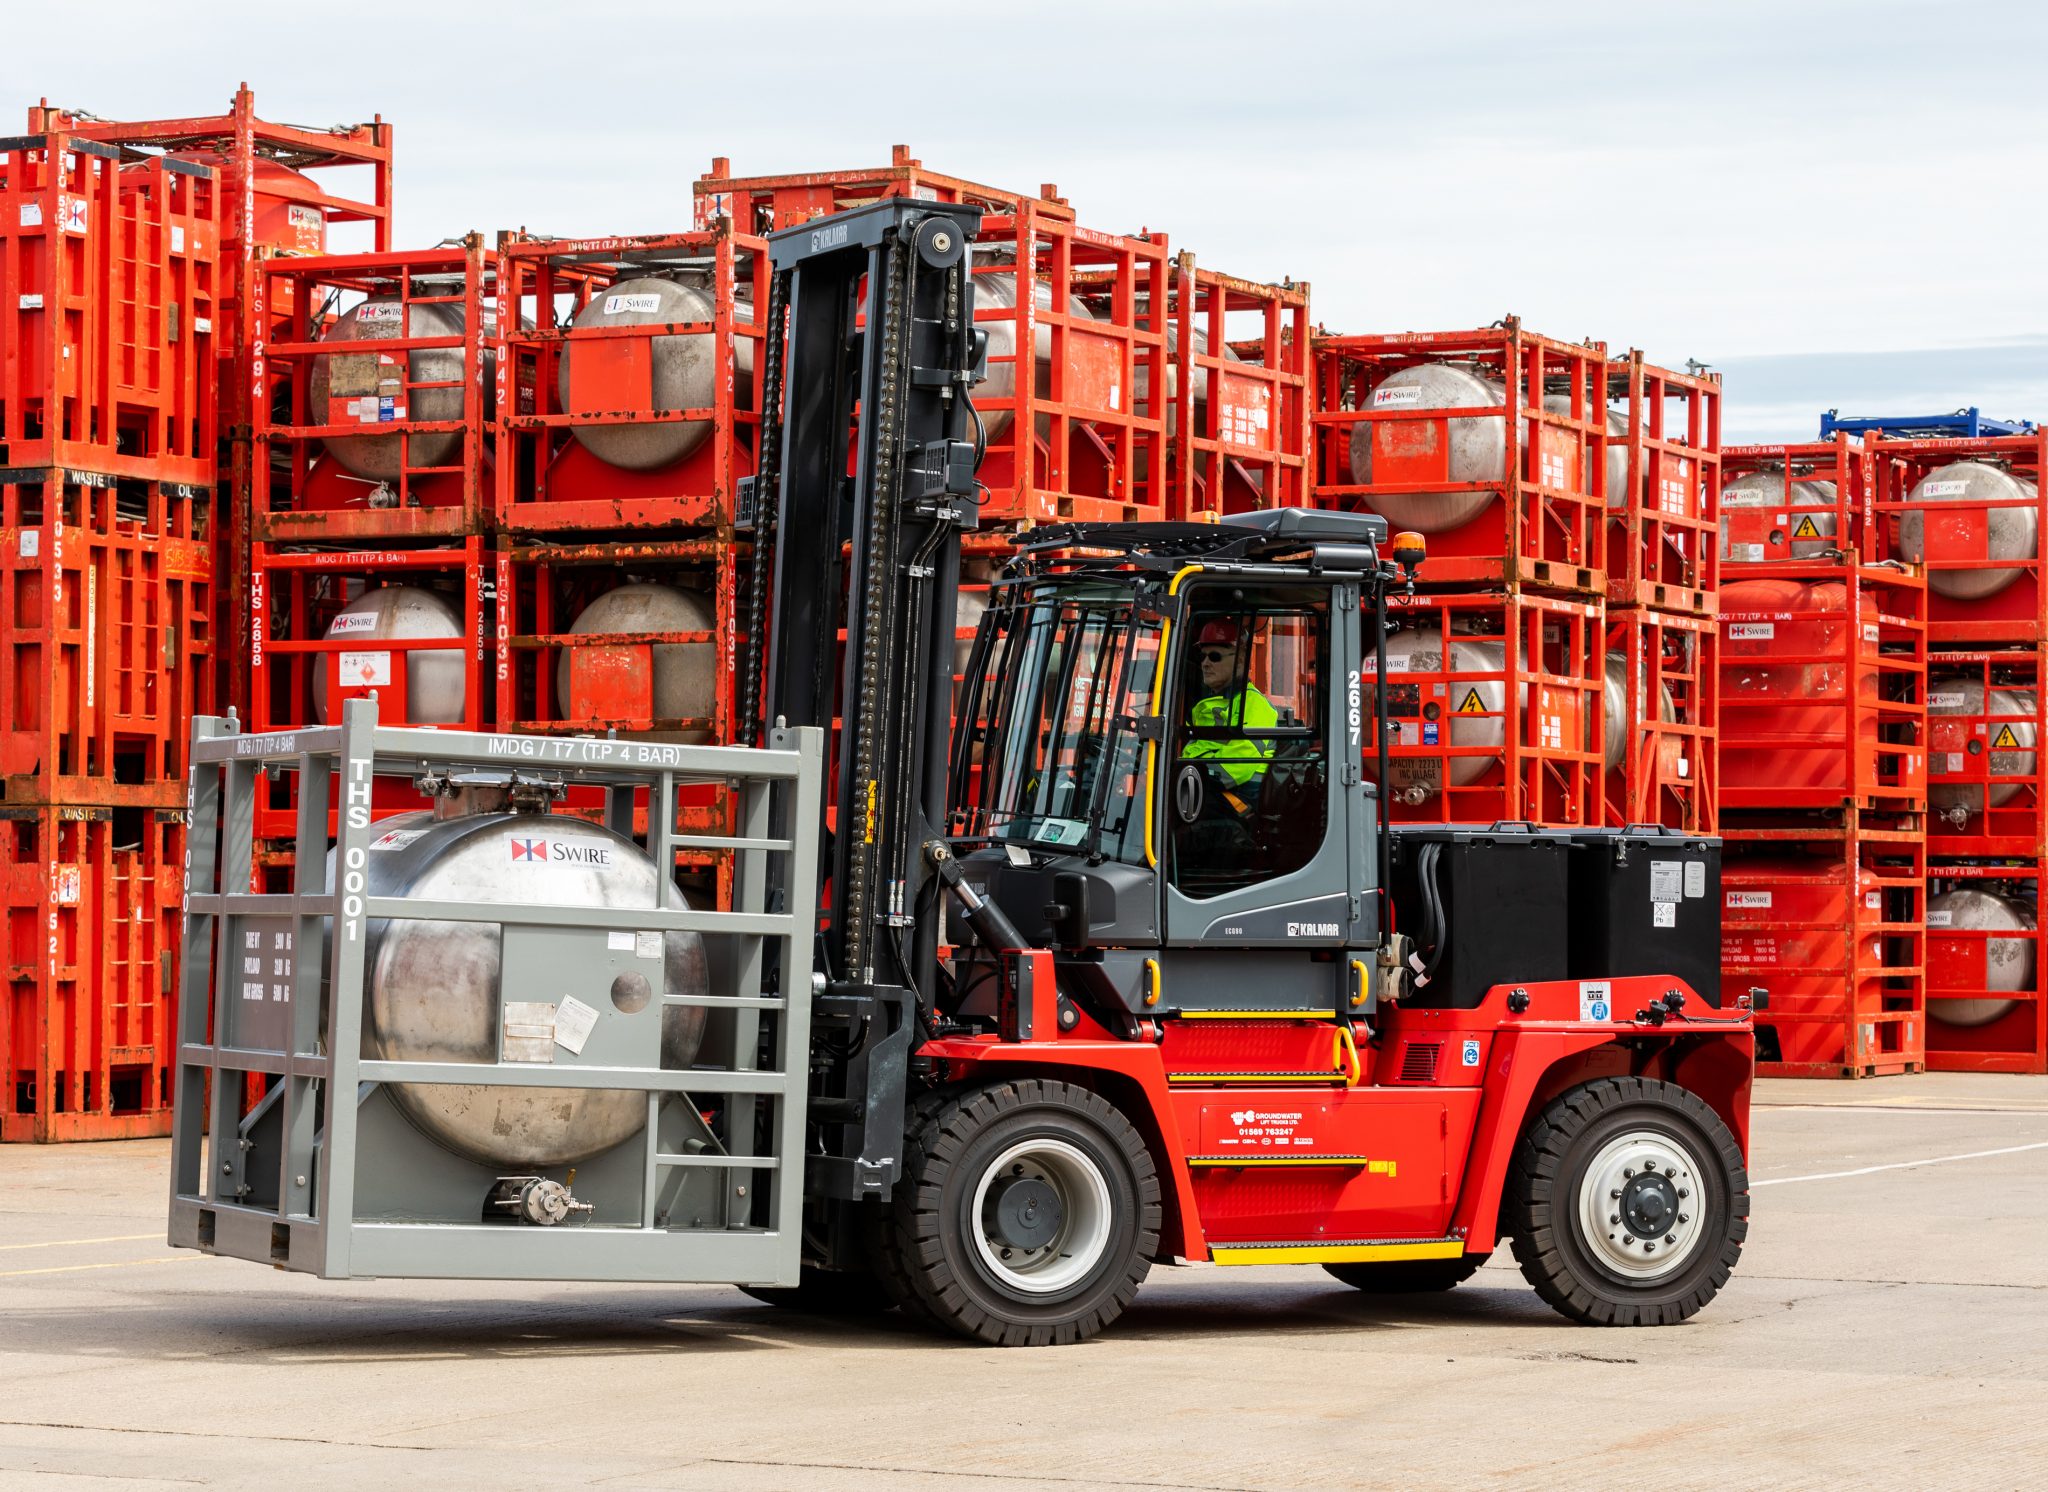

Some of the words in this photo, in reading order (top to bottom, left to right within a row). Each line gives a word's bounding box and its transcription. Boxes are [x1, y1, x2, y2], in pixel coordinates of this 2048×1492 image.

[820, 225, 848, 250] KALMAR
[626, 298, 655, 308] SWIRE
[71, 470, 105, 487] WASTE
[178, 484, 193, 498] OIL
[315, 554, 336, 563] IMDG
[252, 572, 262, 609] THS
[349, 617, 374, 627] SWIRE
[1747, 627, 1772, 636] SWIRE
[252, 617, 262, 667] 2858
[1386, 660, 1407, 668] WIRE
[1348, 670, 1361, 746] 2667
[488, 737, 535, 756] IMDG
[552, 741, 576, 759] T7
[620, 748, 631, 762] 4
[638, 749, 681, 766] BAR)
[186, 765, 196, 831] THS
[346, 758, 371, 829] THS
[552, 842, 611, 865] SWIRE
[182, 848, 192, 936] 0001
[343, 847, 366, 942] 0001
[1744, 896, 1769, 904] SWIRE
[1300, 923, 1339, 937] KALMAR
[49, 913, 58, 977] 521
[1255, 1112, 1303, 1120] GROUNDWATER
[1265, 1128, 1294, 1136] 763247
